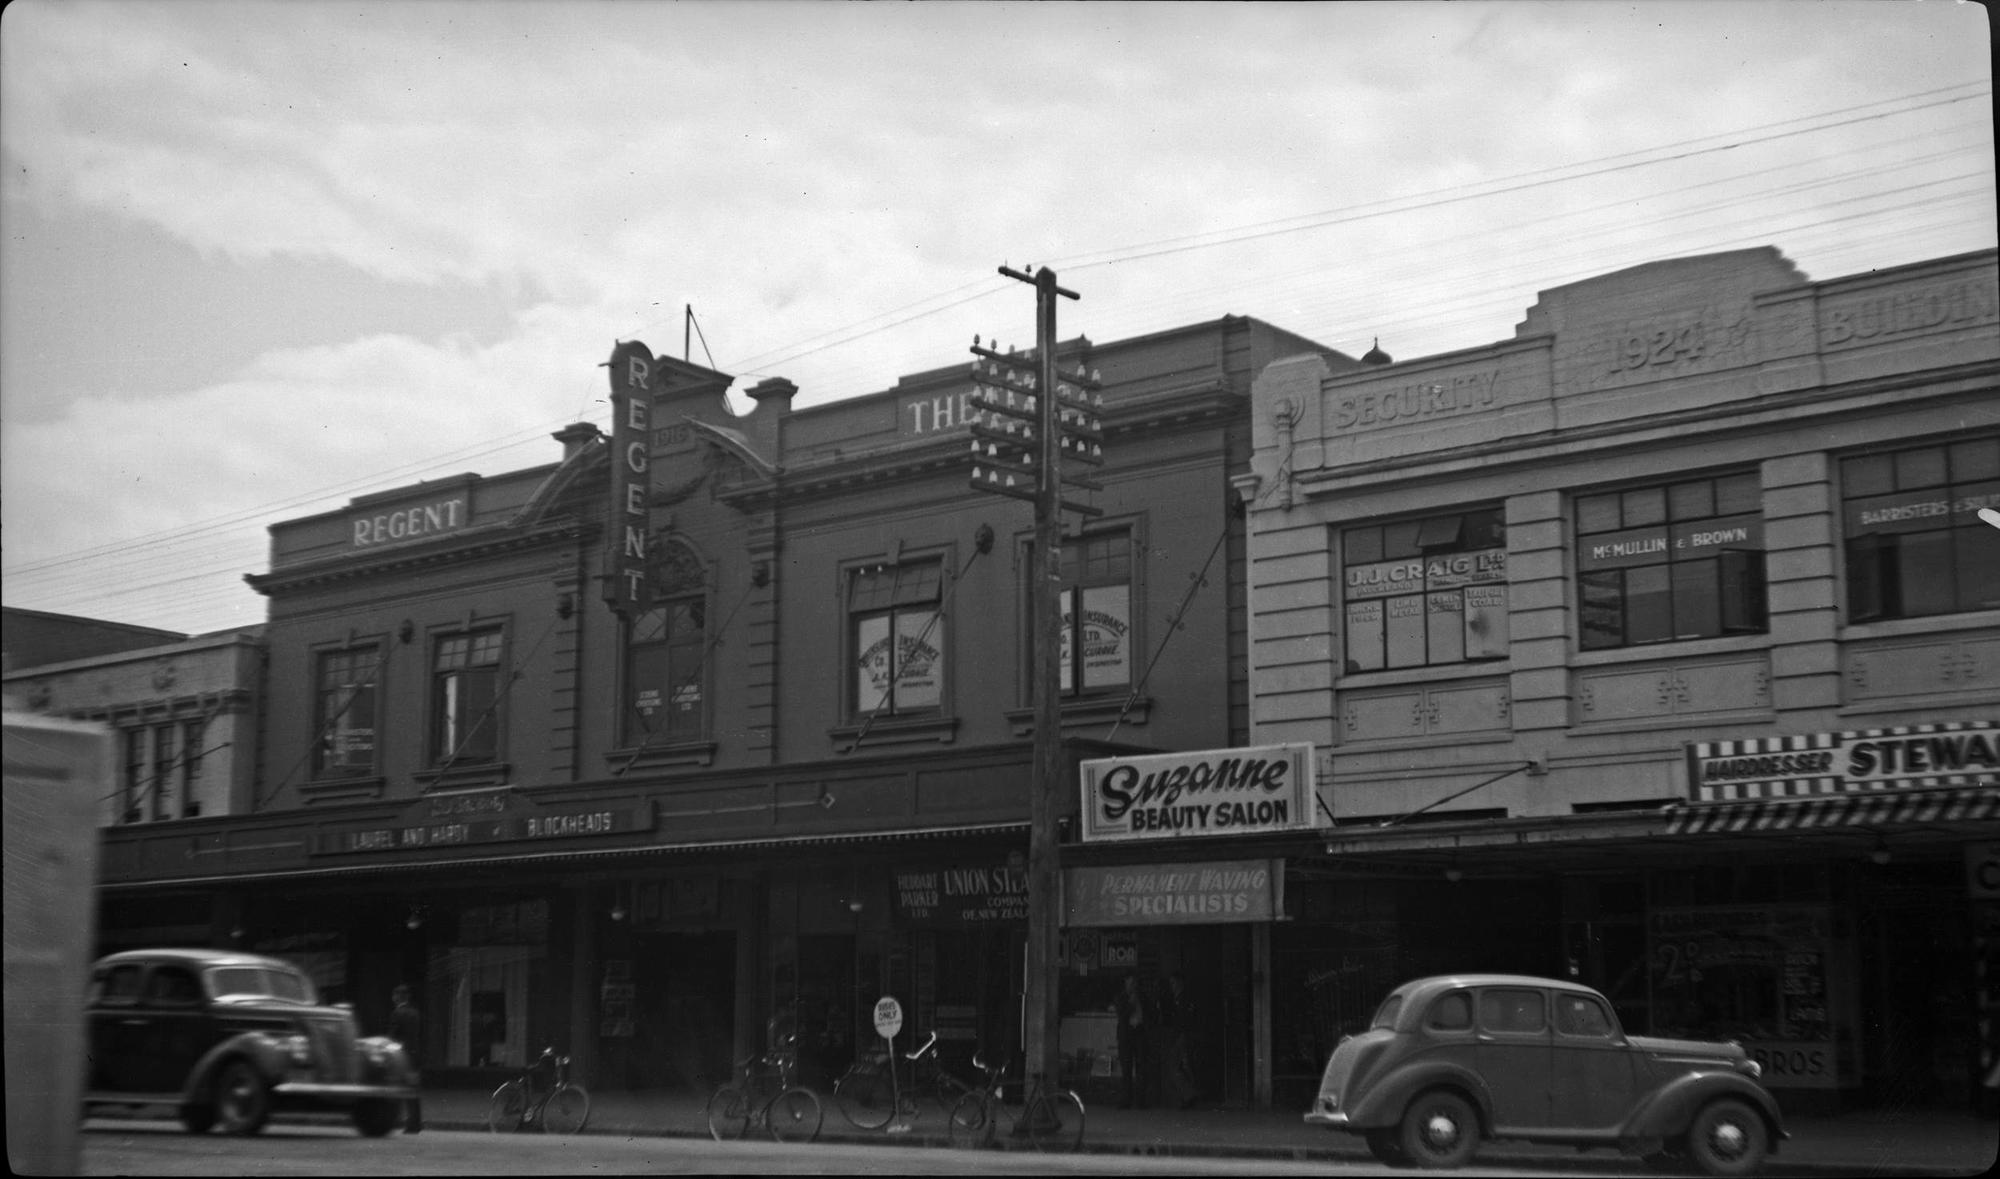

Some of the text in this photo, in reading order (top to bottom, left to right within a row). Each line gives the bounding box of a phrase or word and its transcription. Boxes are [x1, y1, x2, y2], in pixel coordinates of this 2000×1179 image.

[1610, 316, 1706, 374] 1924
[1336, 369, 1499, 429] SECURITY
[624, 355, 649, 602] REGENT
[353, 500, 463, 546] REGENT
[1691, 527, 1748, 548] BROWN
[1706, 733, 2000, 779] HAIRDRESSER STEWA
[1102, 758, 1289, 822] Suzanne
[528, 811, 612, 838] BLOCKHEADS
[1131, 799, 1289, 832] BEAUTY SALON
[944, 868, 991, 896] UNION
[1101, 872, 1196, 896] PERMANENT
[1198, 869, 1267, 891] WAVING
[987, 895, 1032, 908] COMPAN
[1113, 892, 1249, 917] SPECIALISTS
